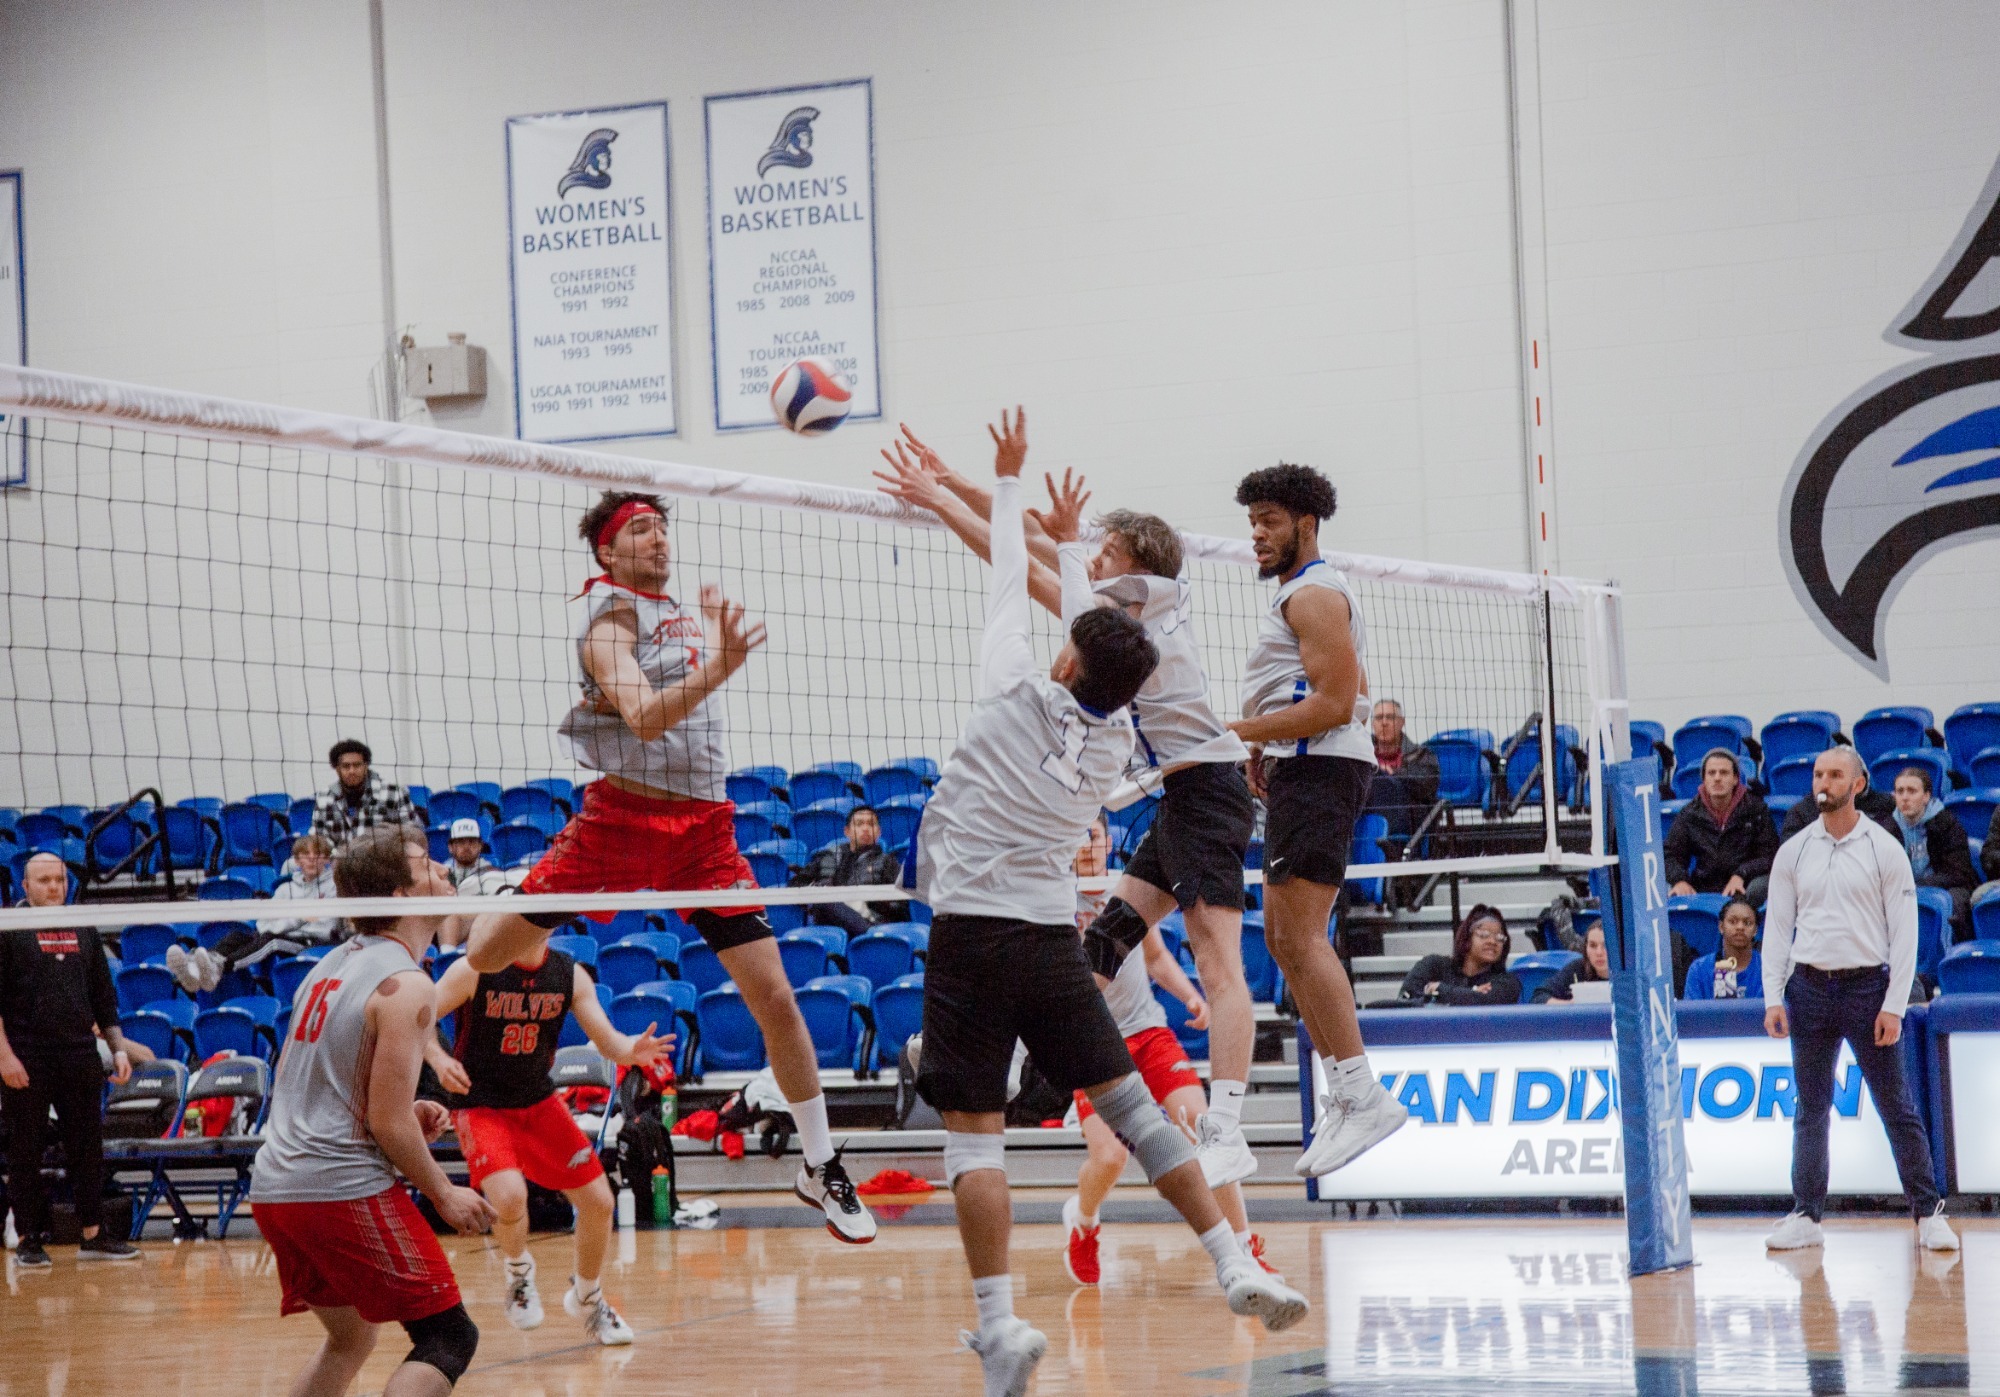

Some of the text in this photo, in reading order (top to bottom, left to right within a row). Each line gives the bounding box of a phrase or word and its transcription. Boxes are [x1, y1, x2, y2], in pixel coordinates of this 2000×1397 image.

[734, 175, 848, 206] WOMEN'S
[535, 196, 646, 225] WOMEN'S
[721, 202, 864, 234] BASKETBALL
[522, 222, 662, 254] BASKETBALL
[770, 249, 818, 264] NCCAA
[550, 264, 637, 284] CONFERENCE
[759, 262, 829, 278] REGIONAL
[553, 280, 635, 298] CHAMPIONS
[752, 275, 837, 294] CHAMPIONS
[561, 296, 629, 313] 1991 1992
[736, 291, 856, 312] 1985 2008 2009
[533, 325, 660, 347] NAIA TOURNAMENT
[773, 330, 821, 345] NCCAA
[561, 343, 633, 360] 1993 1995
[749, 342, 847, 361] TOURNAMENT
[739, 366, 769, 379] 1985
[529, 375, 667, 399] USCAA TOURNAMENT
[739, 381, 770, 395] 2009
[531, 391, 668, 413] 1990 1991 1992 1994
[294, 977, 343, 1043] 15
[485, 989, 565, 1021] WOLVES
[1634, 784, 1681, 1247] TRINITY
[500, 1022, 540, 1056] 26
